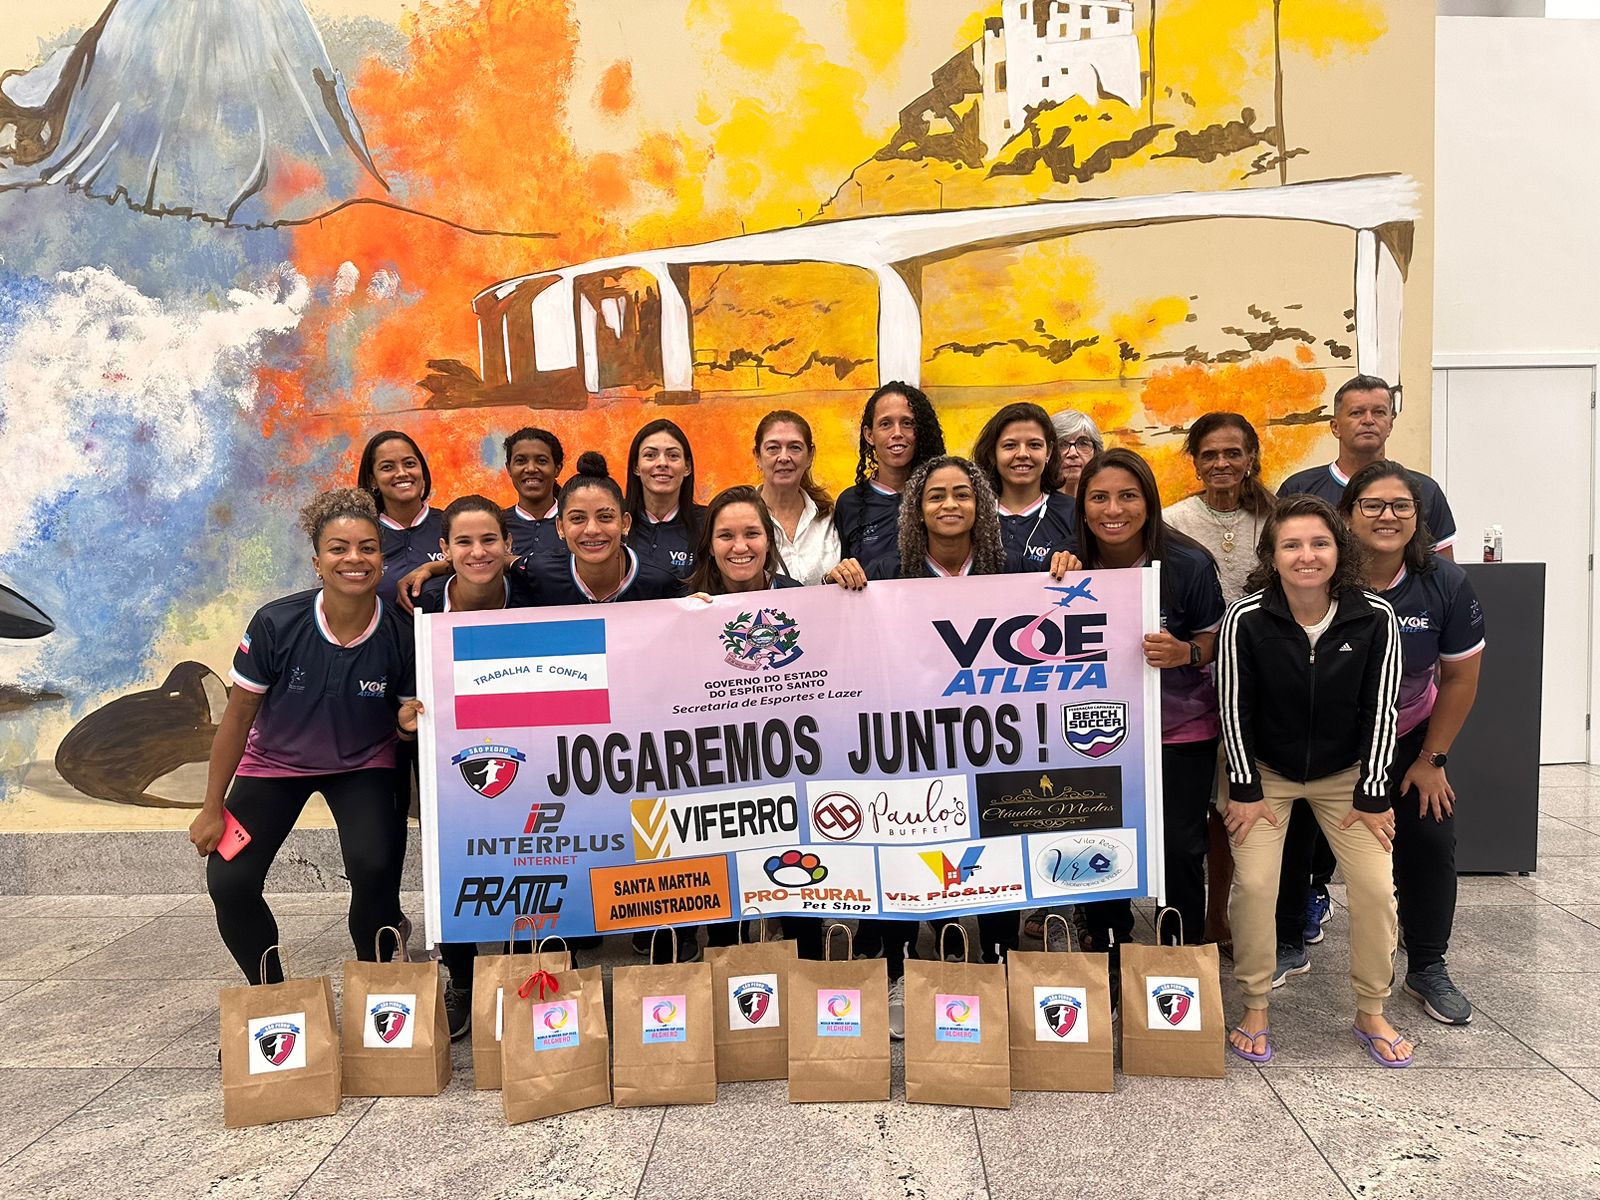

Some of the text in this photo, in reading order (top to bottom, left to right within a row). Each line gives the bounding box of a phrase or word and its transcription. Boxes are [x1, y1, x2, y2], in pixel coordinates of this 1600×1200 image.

[427, 552, 447, 562] VO
[1397, 616, 1429, 629] VOE
[931, 612, 1110, 669] VOE
[473, 664, 589, 686] TRABALHA E CONFIA
[704, 669, 829, 689] GOVERNO DO ESTADO
[941, 662, 1108, 697] ATLETA
[709, 678, 826, 699] DO ESPÍRITO SANTO
[671, 688, 863, 715] Secretaria de Esportes e Lazer
[1069, 718, 1122, 729] SOCCER
[1073, 710, 1118, 720] BEACH
[547, 714, 823, 798] JOGAREMOS
[848, 702, 1022, 775] JUNTOS
[868, 779, 967, 834] Paulo's
[1047, 802, 1114, 816] Modas
[670, 795, 799, 844] VIFERRO
[888, 825, 949, 836] BUFFET
[467, 833, 626, 856] INTERPLUS
[1073, 837, 1120, 851] Vila Real
[513, 855, 578, 867] INTERNET
[614, 871, 712, 898] SANTA MARTHA
[885, 883, 1022, 902] Vix Pio&Lyra
[453, 874, 569, 918] PRATIC
[743, 887, 873, 904] PRO-RURAL
[610, 893, 722, 921] ADMINISTRADORA
[802, 901, 872, 913] Pet Shop
